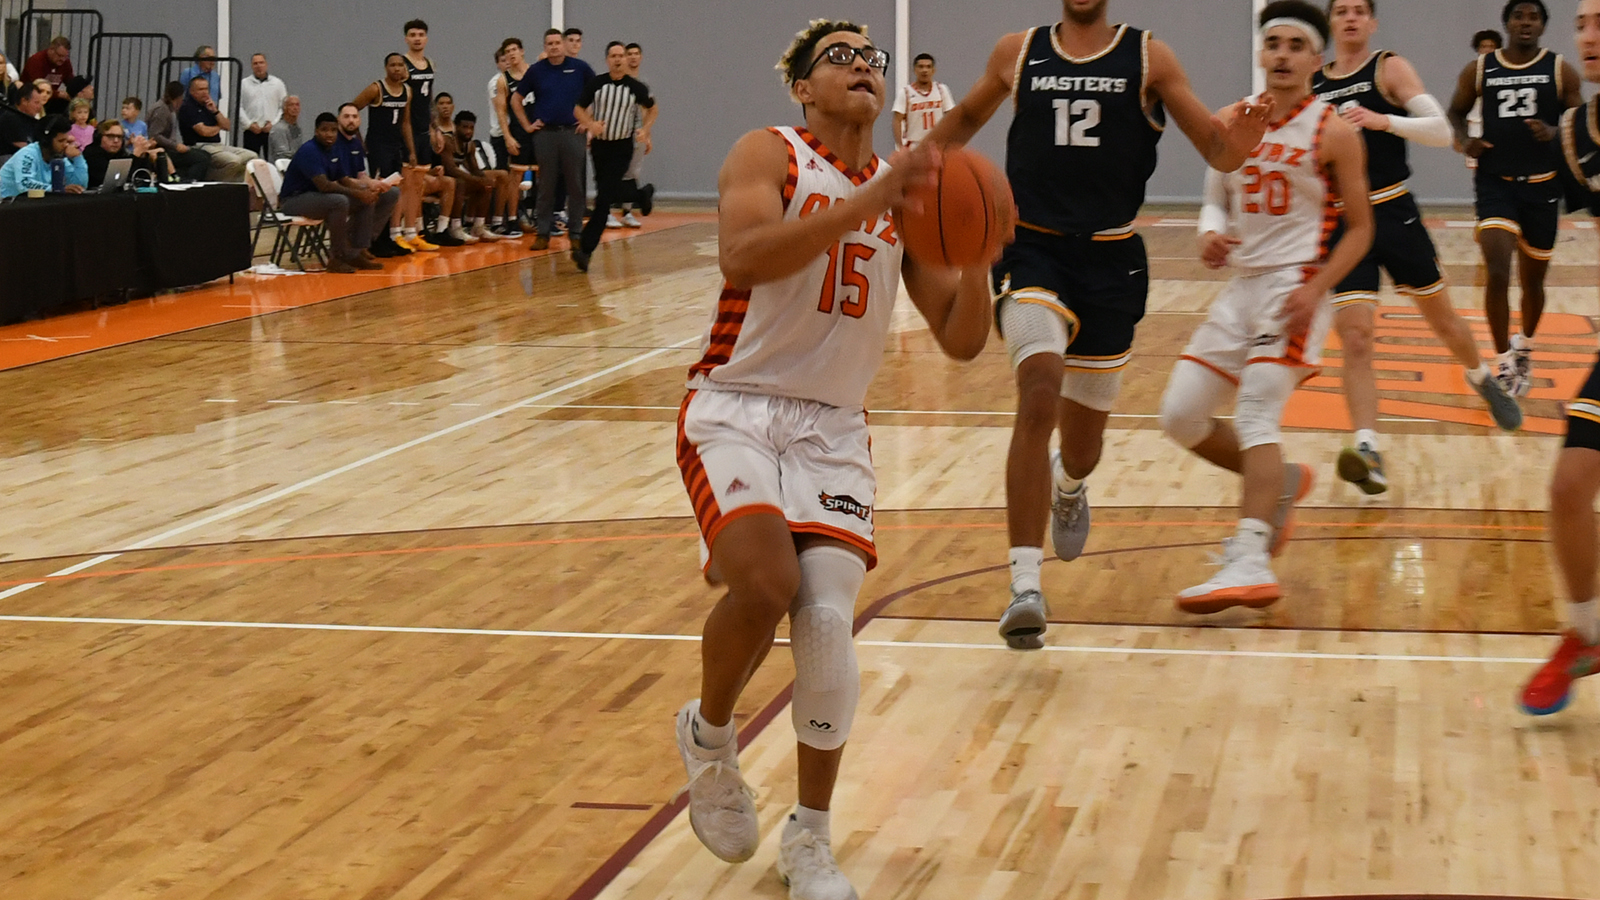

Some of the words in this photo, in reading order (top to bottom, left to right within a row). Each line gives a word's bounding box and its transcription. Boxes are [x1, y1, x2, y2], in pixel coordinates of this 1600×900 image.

[1031, 76, 1127, 93] MASTER'S
[1497, 87, 1538, 118] 23
[1052, 98, 1101, 147] 12
[1242, 165, 1290, 216] 20
[817, 240, 877, 319] 15
[825, 498, 868, 518] SPIRIT
